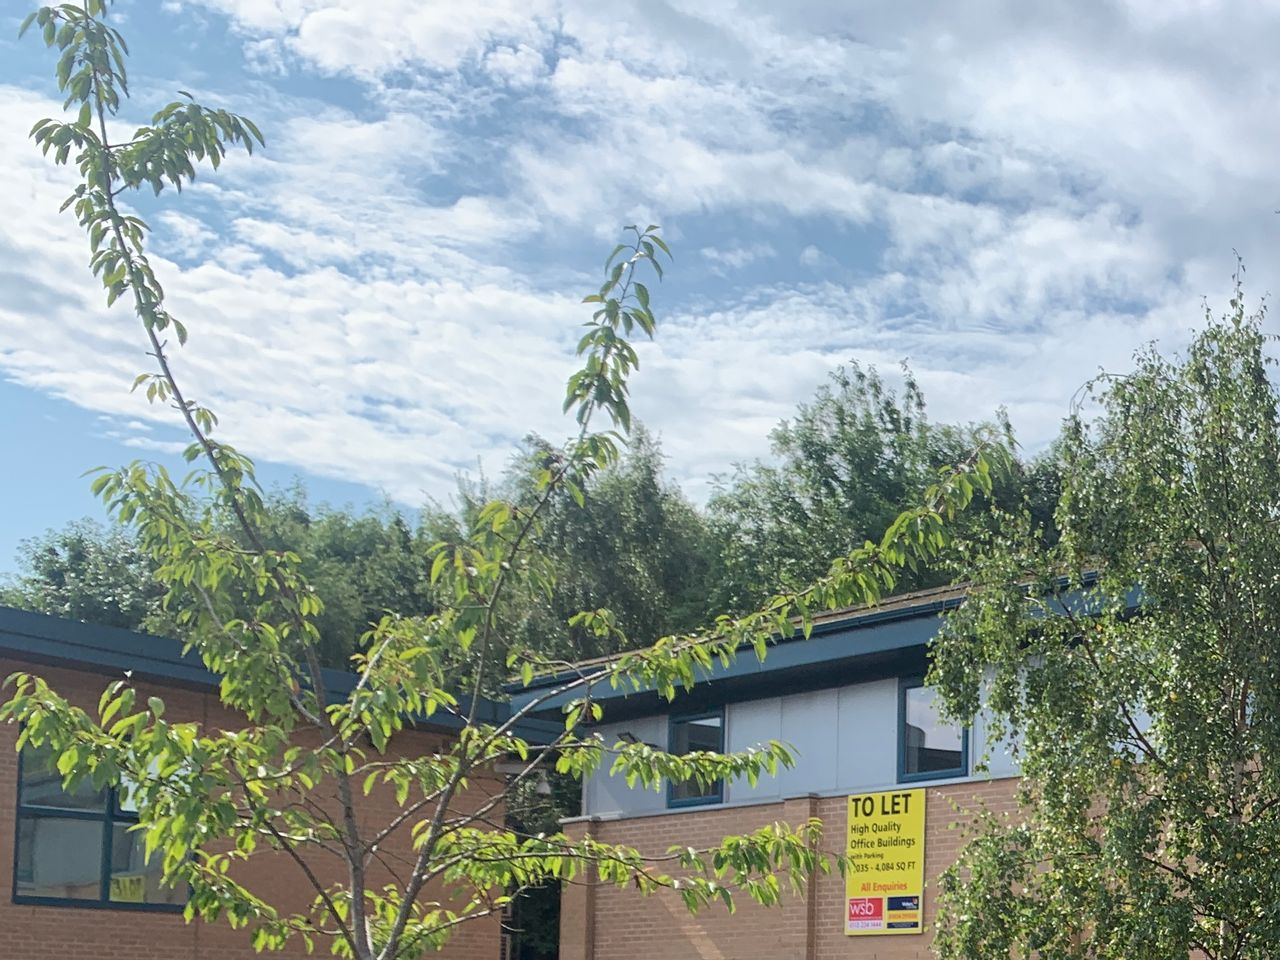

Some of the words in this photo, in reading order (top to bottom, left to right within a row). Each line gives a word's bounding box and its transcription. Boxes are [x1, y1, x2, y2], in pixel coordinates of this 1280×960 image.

[852, 797, 875, 818] TO
[881, 794, 912, 815] LET
[851, 823, 869, 836] High
[872, 822, 902, 834] Quality
[851, 838, 875, 849] Office
[877, 836, 915, 848] Buildings
[864, 852, 884, 860] Parking
[896, 861, 906, 871] SQ
[907, 861, 916, 870] FT
[861, 882, 871, 892] All
[873, 881, 908, 893] Enquiries
[850, 898, 874, 915] wsb
